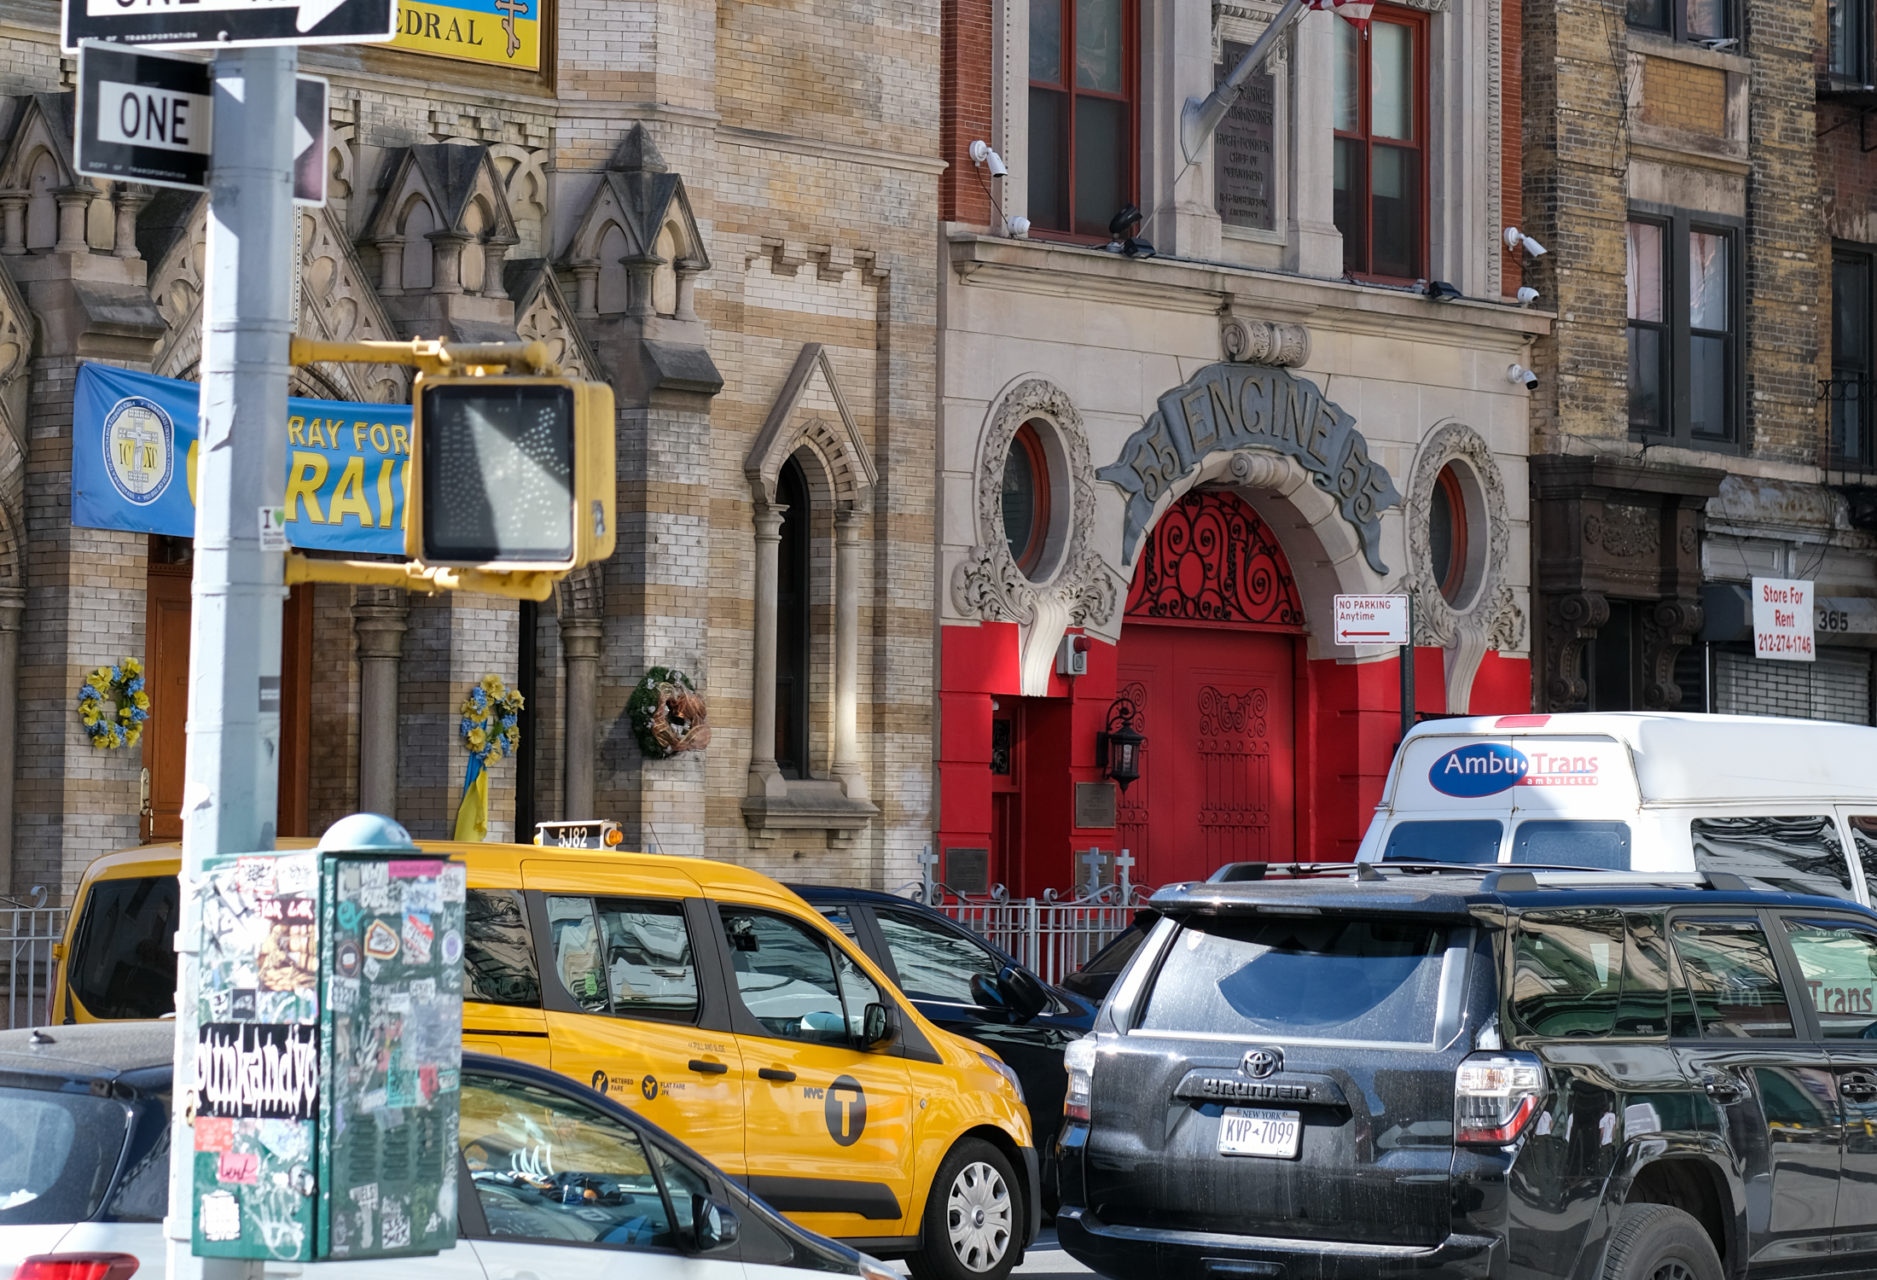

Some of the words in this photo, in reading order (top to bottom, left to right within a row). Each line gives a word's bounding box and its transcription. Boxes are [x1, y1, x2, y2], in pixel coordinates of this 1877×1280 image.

[120, 91, 190, 145] ONE
[352, 422, 410, 456] FOR
[1131, 421, 1181, 503] 55
[1181, 376, 1339, 467] ENGINE
[1337, 439, 1384, 524] 55
[284, 451, 410, 530] RAI
[1339, 600, 1351, 610] NO
[1354, 600, 1391, 610] PARKING
[1763, 584, 1788, 604] Store
[1790, 586, 1804, 605] For
[1339, 611, 1375, 621] Anytime
[1775, 609, 1795, 628] Rent
[1818, 610, 1849, 631] 365
[1758, 633, 1812, 654] 212-274-1746
[1444, 752, 1518, 774] Ambu
[1531, 753, 1599, 775] Trans
[558, 826, 588, 848] 5J82
[1807, 980, 1873, 1014] Trans
[610, 1076, 634, 1086] METERED
[610, 1084, 624, 1092] FARE
[673, 1082, 686, 1091] FARE
[803, 1087, 824, 1100] NYC
[1242, 1110, 1260, 1119] NEW
[1261, 1111, 1282, 1120] YORK
[1226, 1118, 1252, 1142] KVP
[1260, 1121, 1294, 1145] 7099
